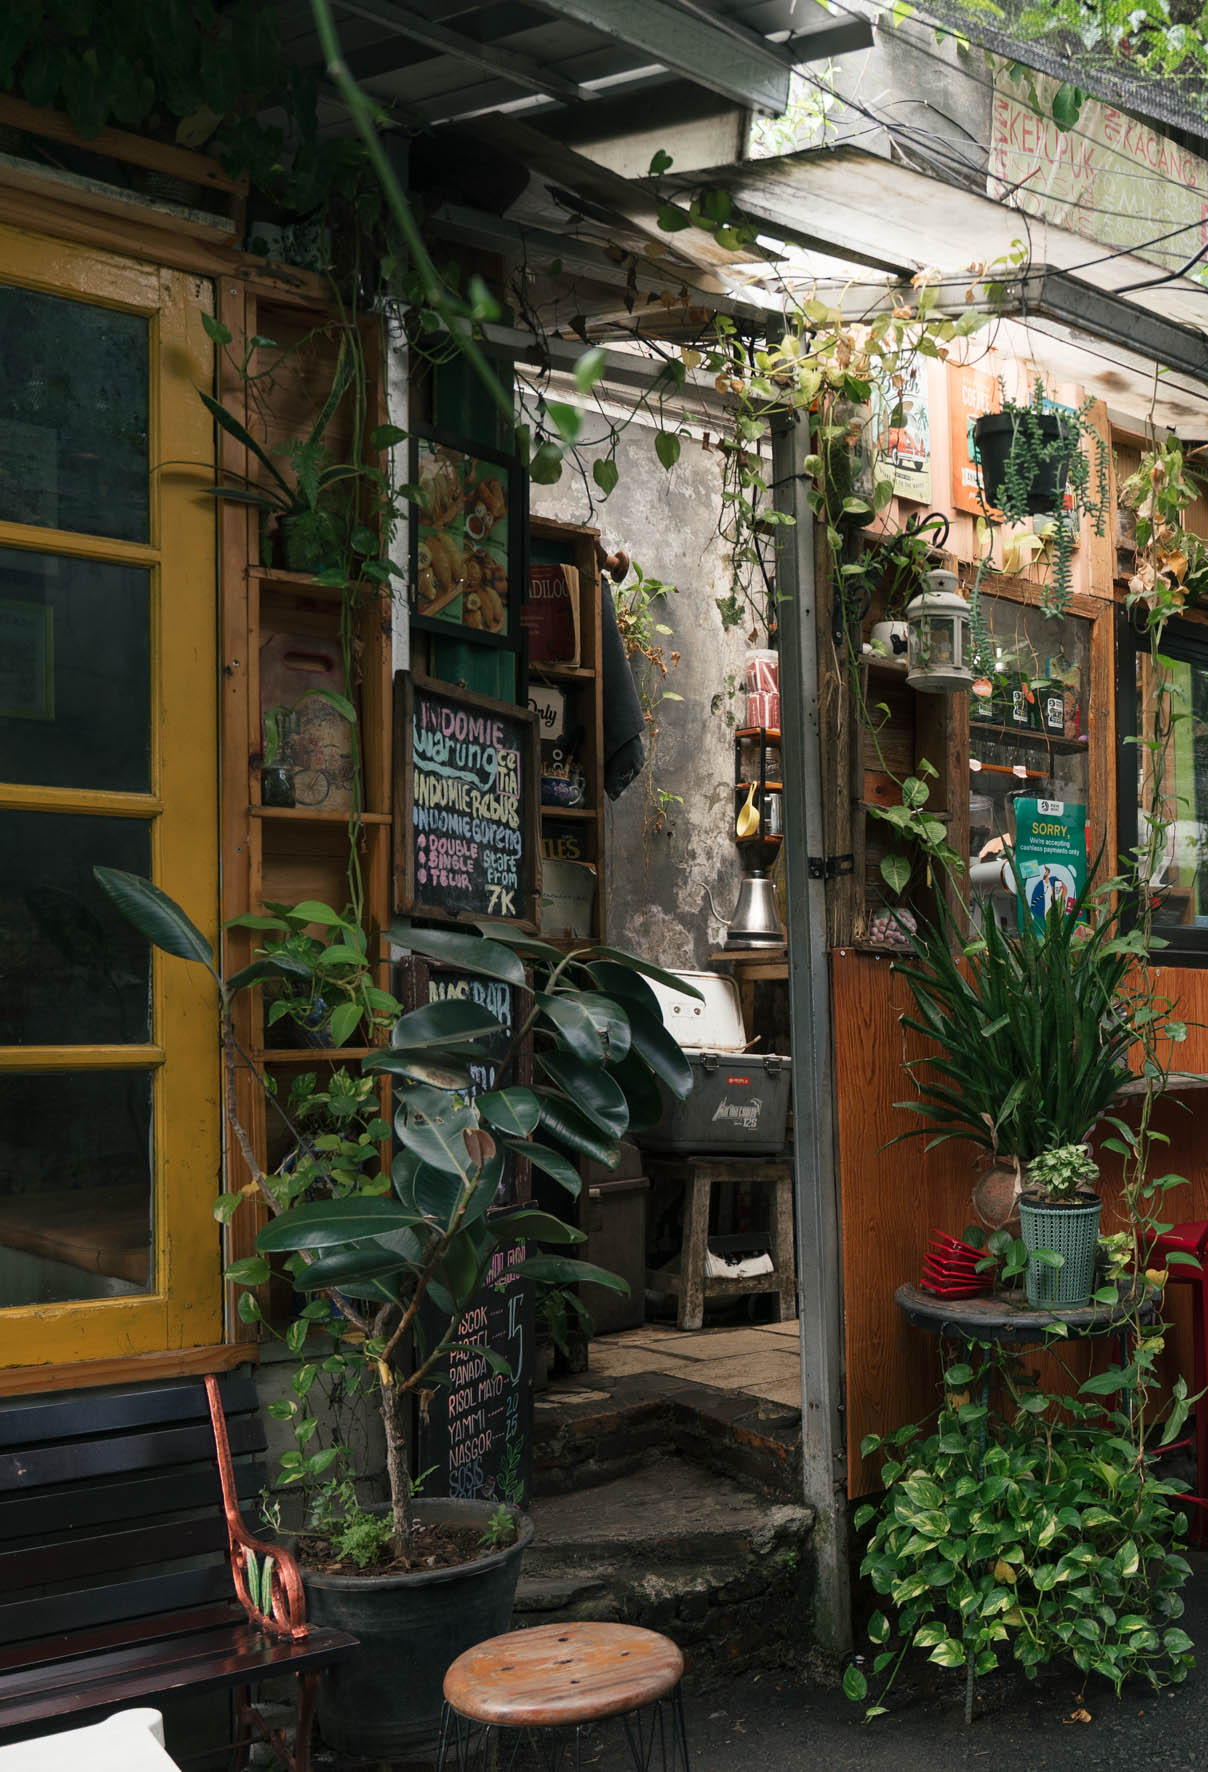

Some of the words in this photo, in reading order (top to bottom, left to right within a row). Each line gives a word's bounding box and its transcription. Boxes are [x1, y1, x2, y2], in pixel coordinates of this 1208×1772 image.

[1122, 122, 1198, 188] KACANG
[421, 702, 505, 748] INDOMIE
[413, 771, 472, 813] INDOMIE
[413, 808, 472, 839] INDOMIE
[1032, 822, 1071, 840] SORRY,
[429, 835, 479, 858] DOUBLE
[1068, 848, 1080, 856] only
[428, 852, 475, 873] SINGLE
[486, 886, 517, 915] 7K
[450, 1306, 489, 1336] ISCOK
[448, 1357, 488, 1389] PANADA
[448, 1388, 477, 1419] RISOL
[478, 1376, 504, 1403] MAYO
[447, 1409, 486, 1446] YAMMI
[505, 1391, 520, 1417] 20
[449, 1430, 493, 1472] NASGOR
[505, 1413, 519, 1441] 25
